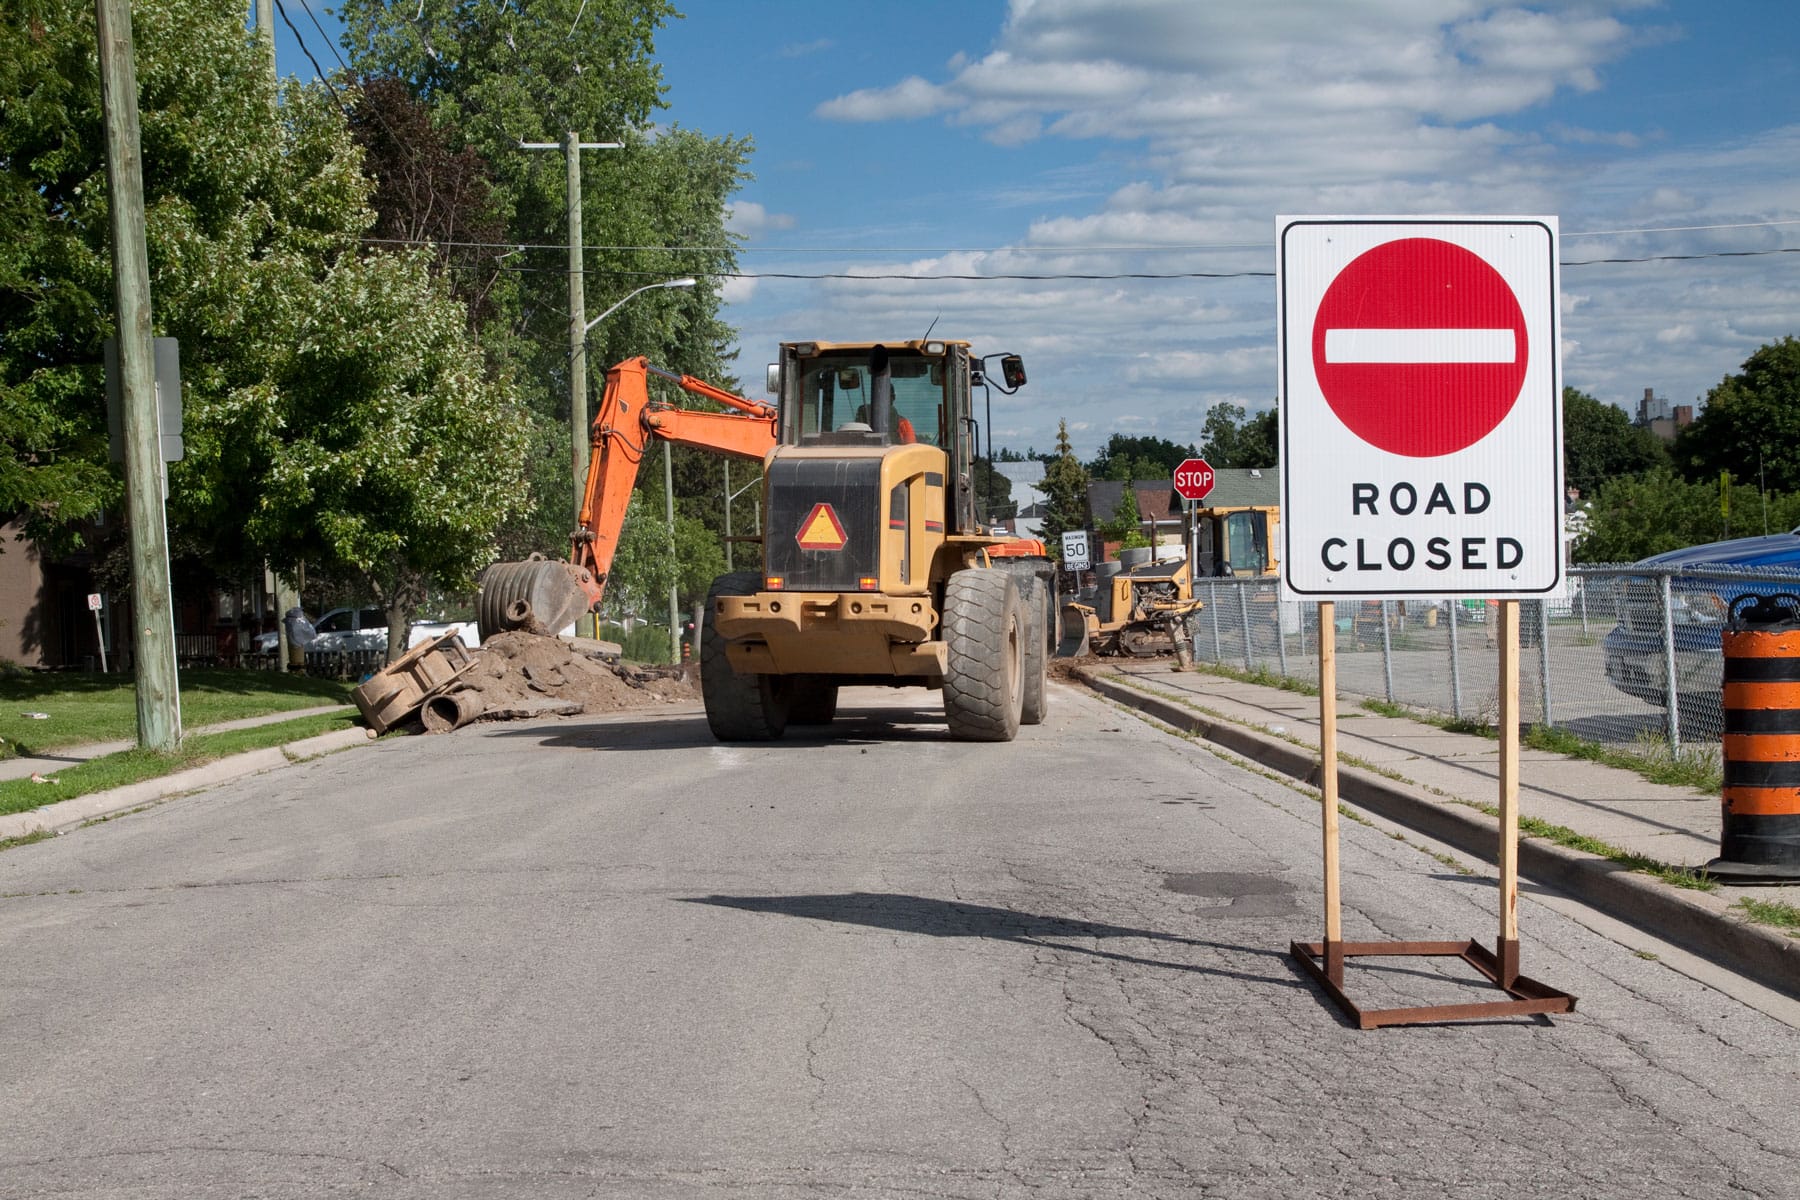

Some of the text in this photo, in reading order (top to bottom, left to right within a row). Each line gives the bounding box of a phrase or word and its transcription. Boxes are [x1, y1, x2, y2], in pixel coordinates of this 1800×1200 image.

[1177, 471, 1212, 487] STOP
[1352, 481, 1491, 516] ROAD
[1066, 543, 1085, 557] 50
[1321, 537, 1524, 572] CLOSED
